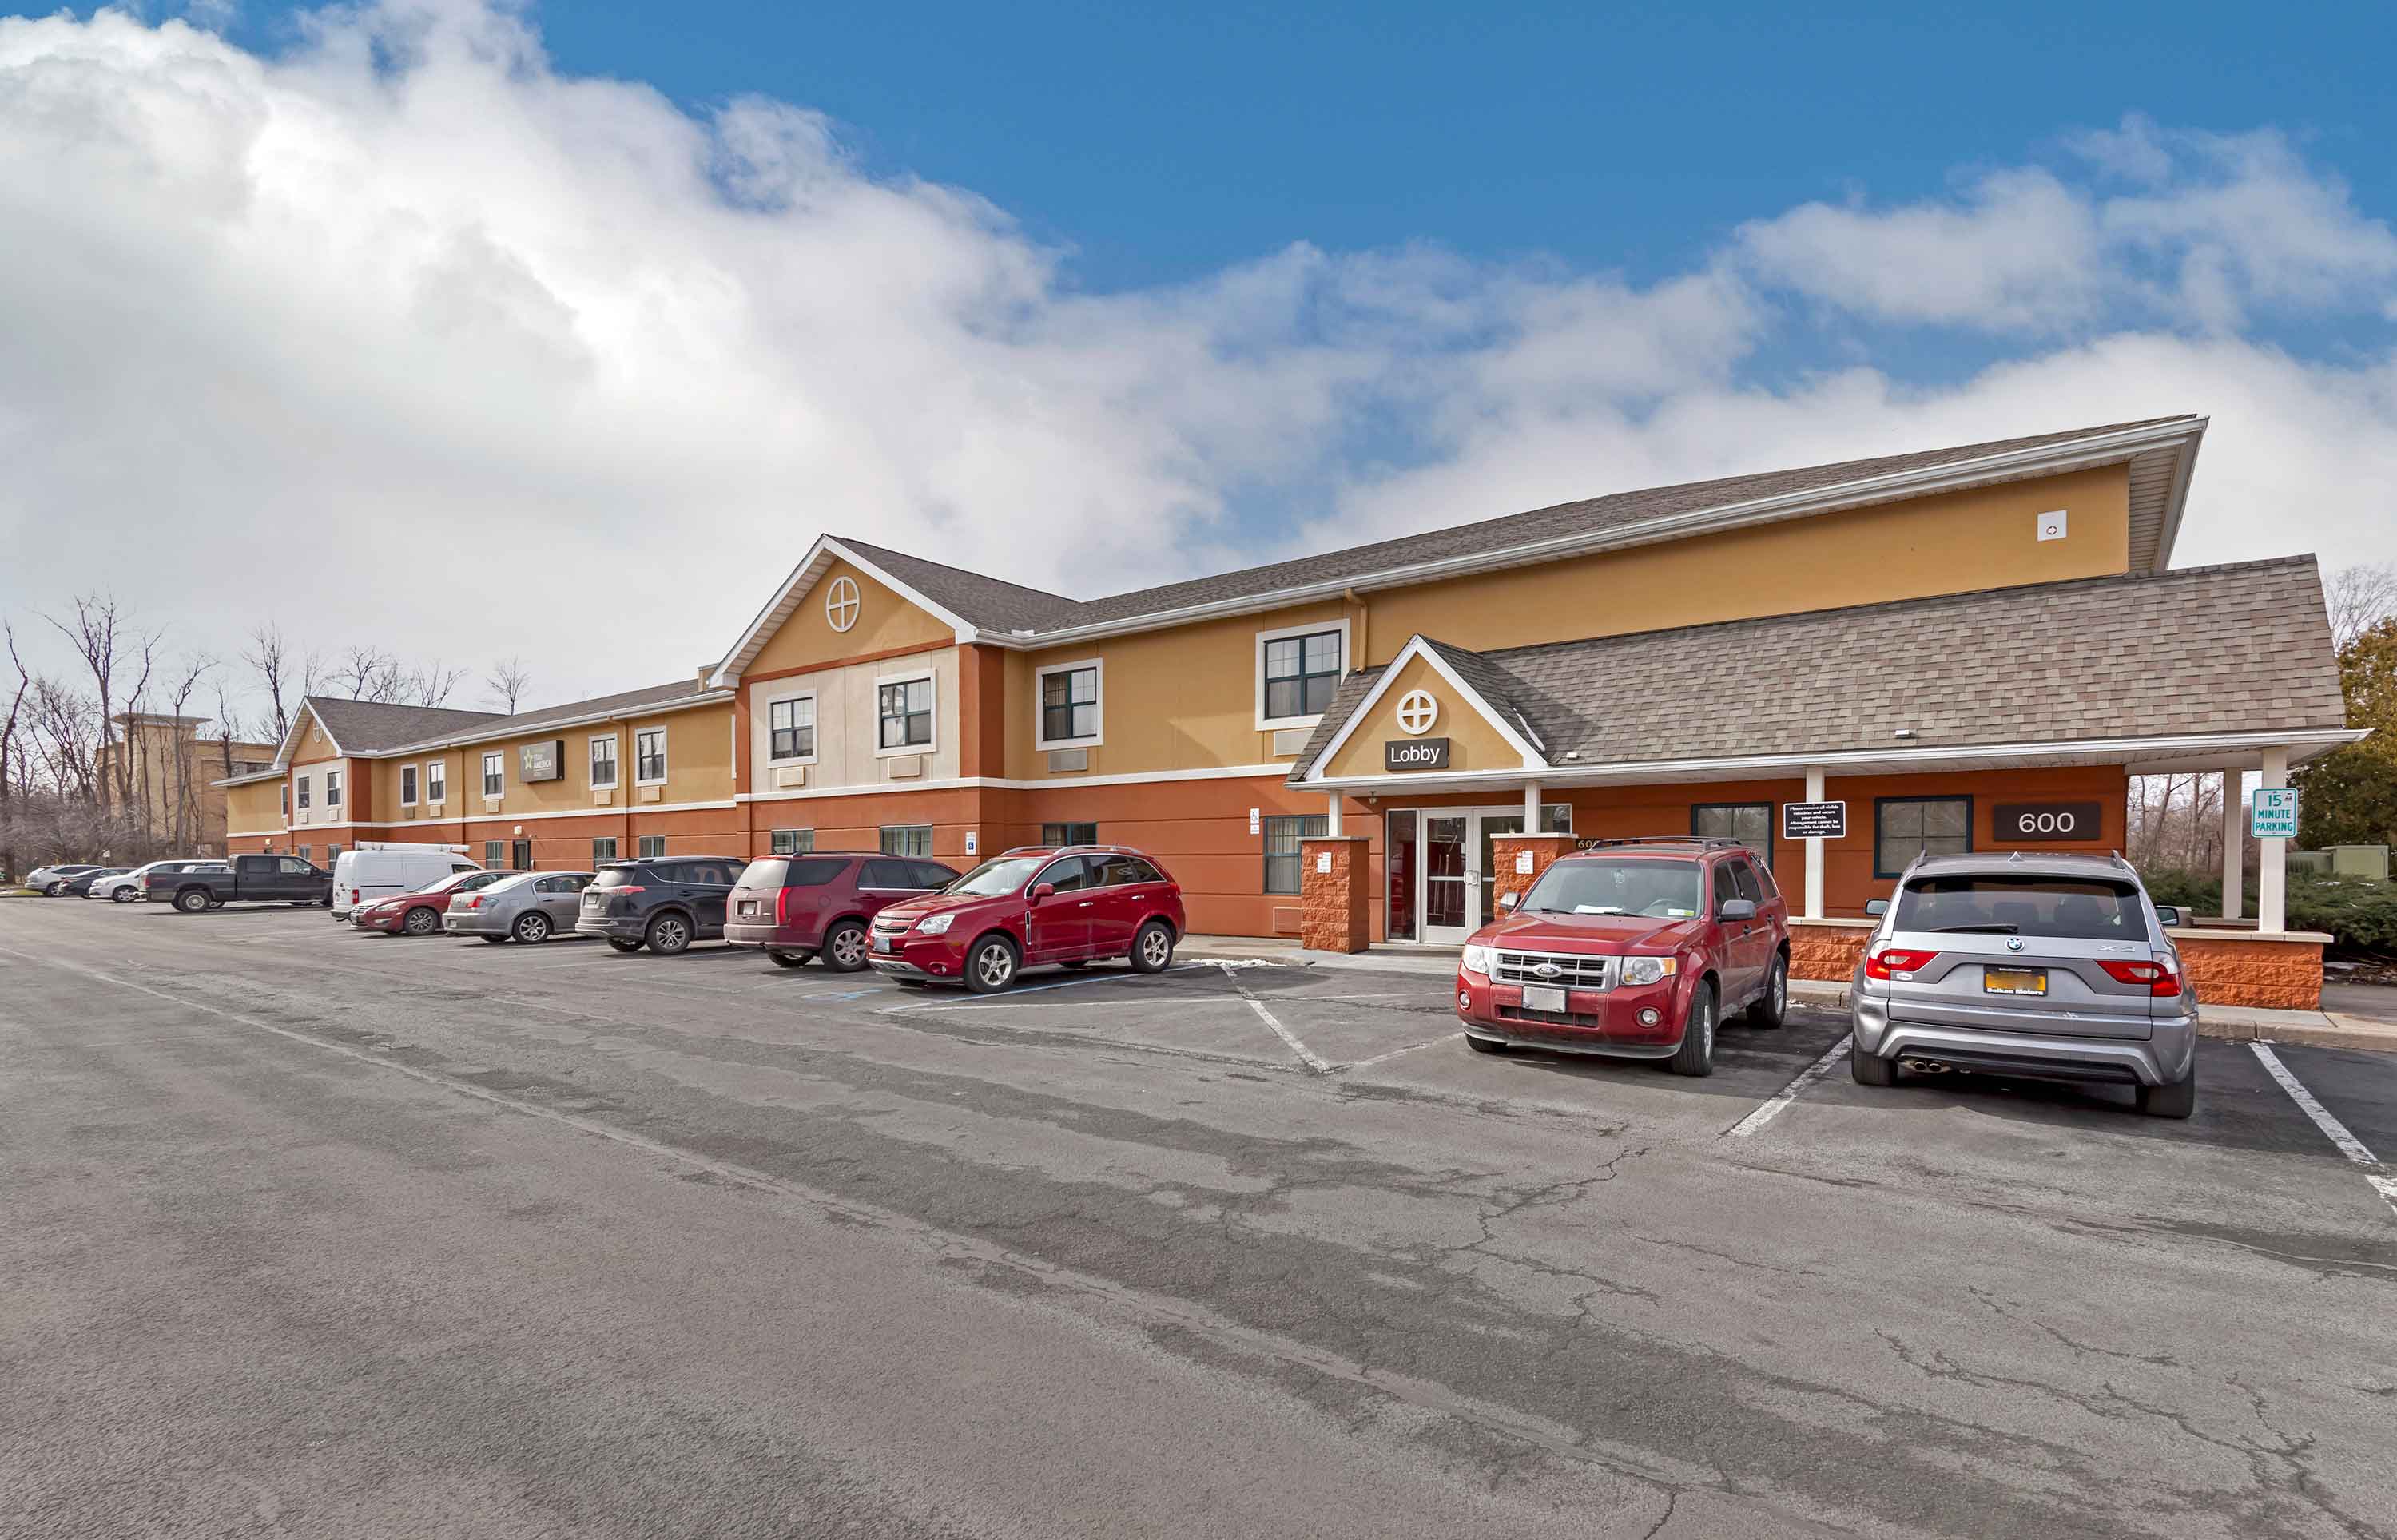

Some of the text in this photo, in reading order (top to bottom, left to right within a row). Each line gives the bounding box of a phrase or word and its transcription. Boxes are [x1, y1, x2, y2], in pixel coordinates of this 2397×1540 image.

[1391, 745, 1440, 764] Lobby
[2268, 794, 2282, 807] 15
[2258, 809, 2290, 819] MINUTE
[2019, 812, 2075, 832] 600
[2256, 822, 2293, 832] PARKING
